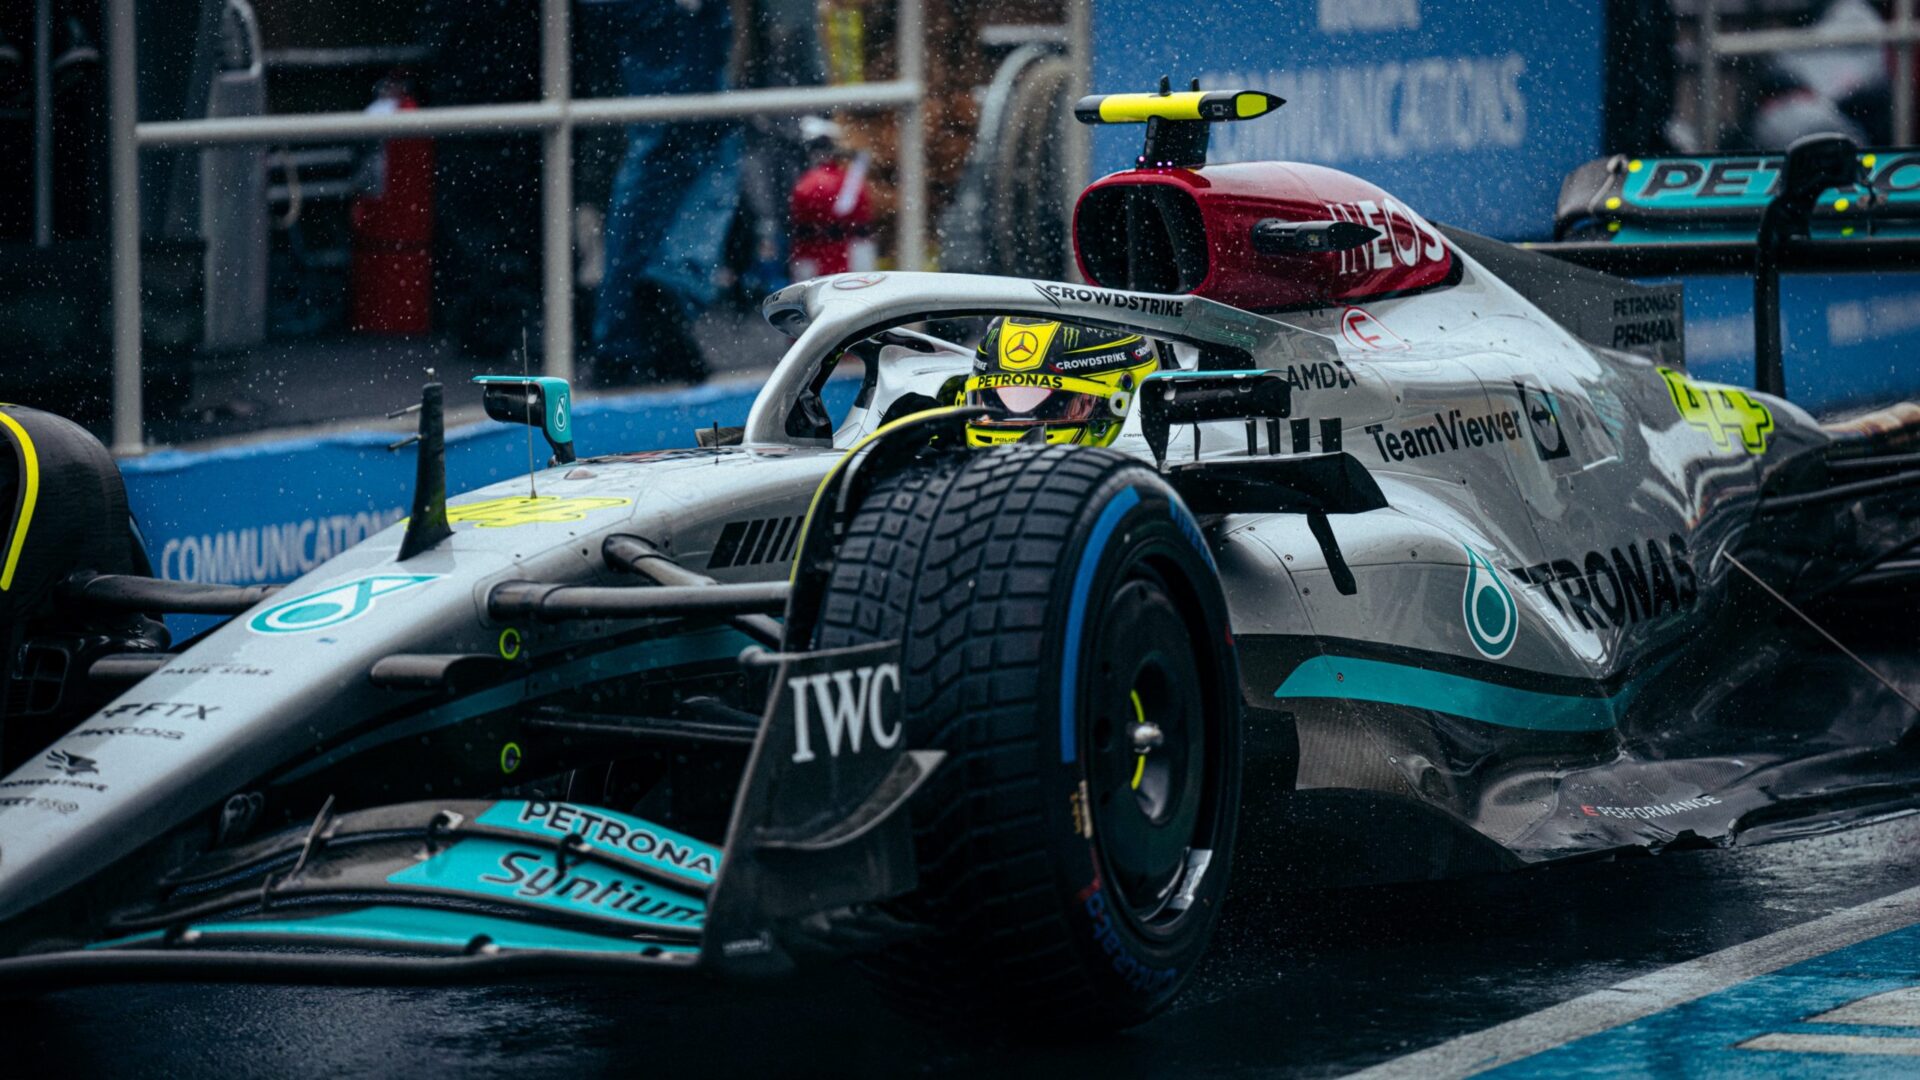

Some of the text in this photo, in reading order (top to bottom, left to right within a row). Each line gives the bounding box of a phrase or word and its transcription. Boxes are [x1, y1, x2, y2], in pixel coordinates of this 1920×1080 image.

[1326, 198, 1445, 276] INEOS
[1046, 284, 1183, 317] CROWDSTRIKE
[1613, 293, 1677, 317] PETRONAS
[1056, 351, 1127, 370] CROWDSTRIKE
[1287, 361, 1340, 392] AMD
[978, 373, 1063, 388] PETRONAS
[1655, 366, 1774, 455] 44
[1366, 408, 1524, 463] TeamViewer
[134, 702, 222, 721] FTX
[788, 663, 901, 763] IWC
[1598, 794, 1723, 819] PERFORMANCE
[519, 799, 714, 876] PETRONA
